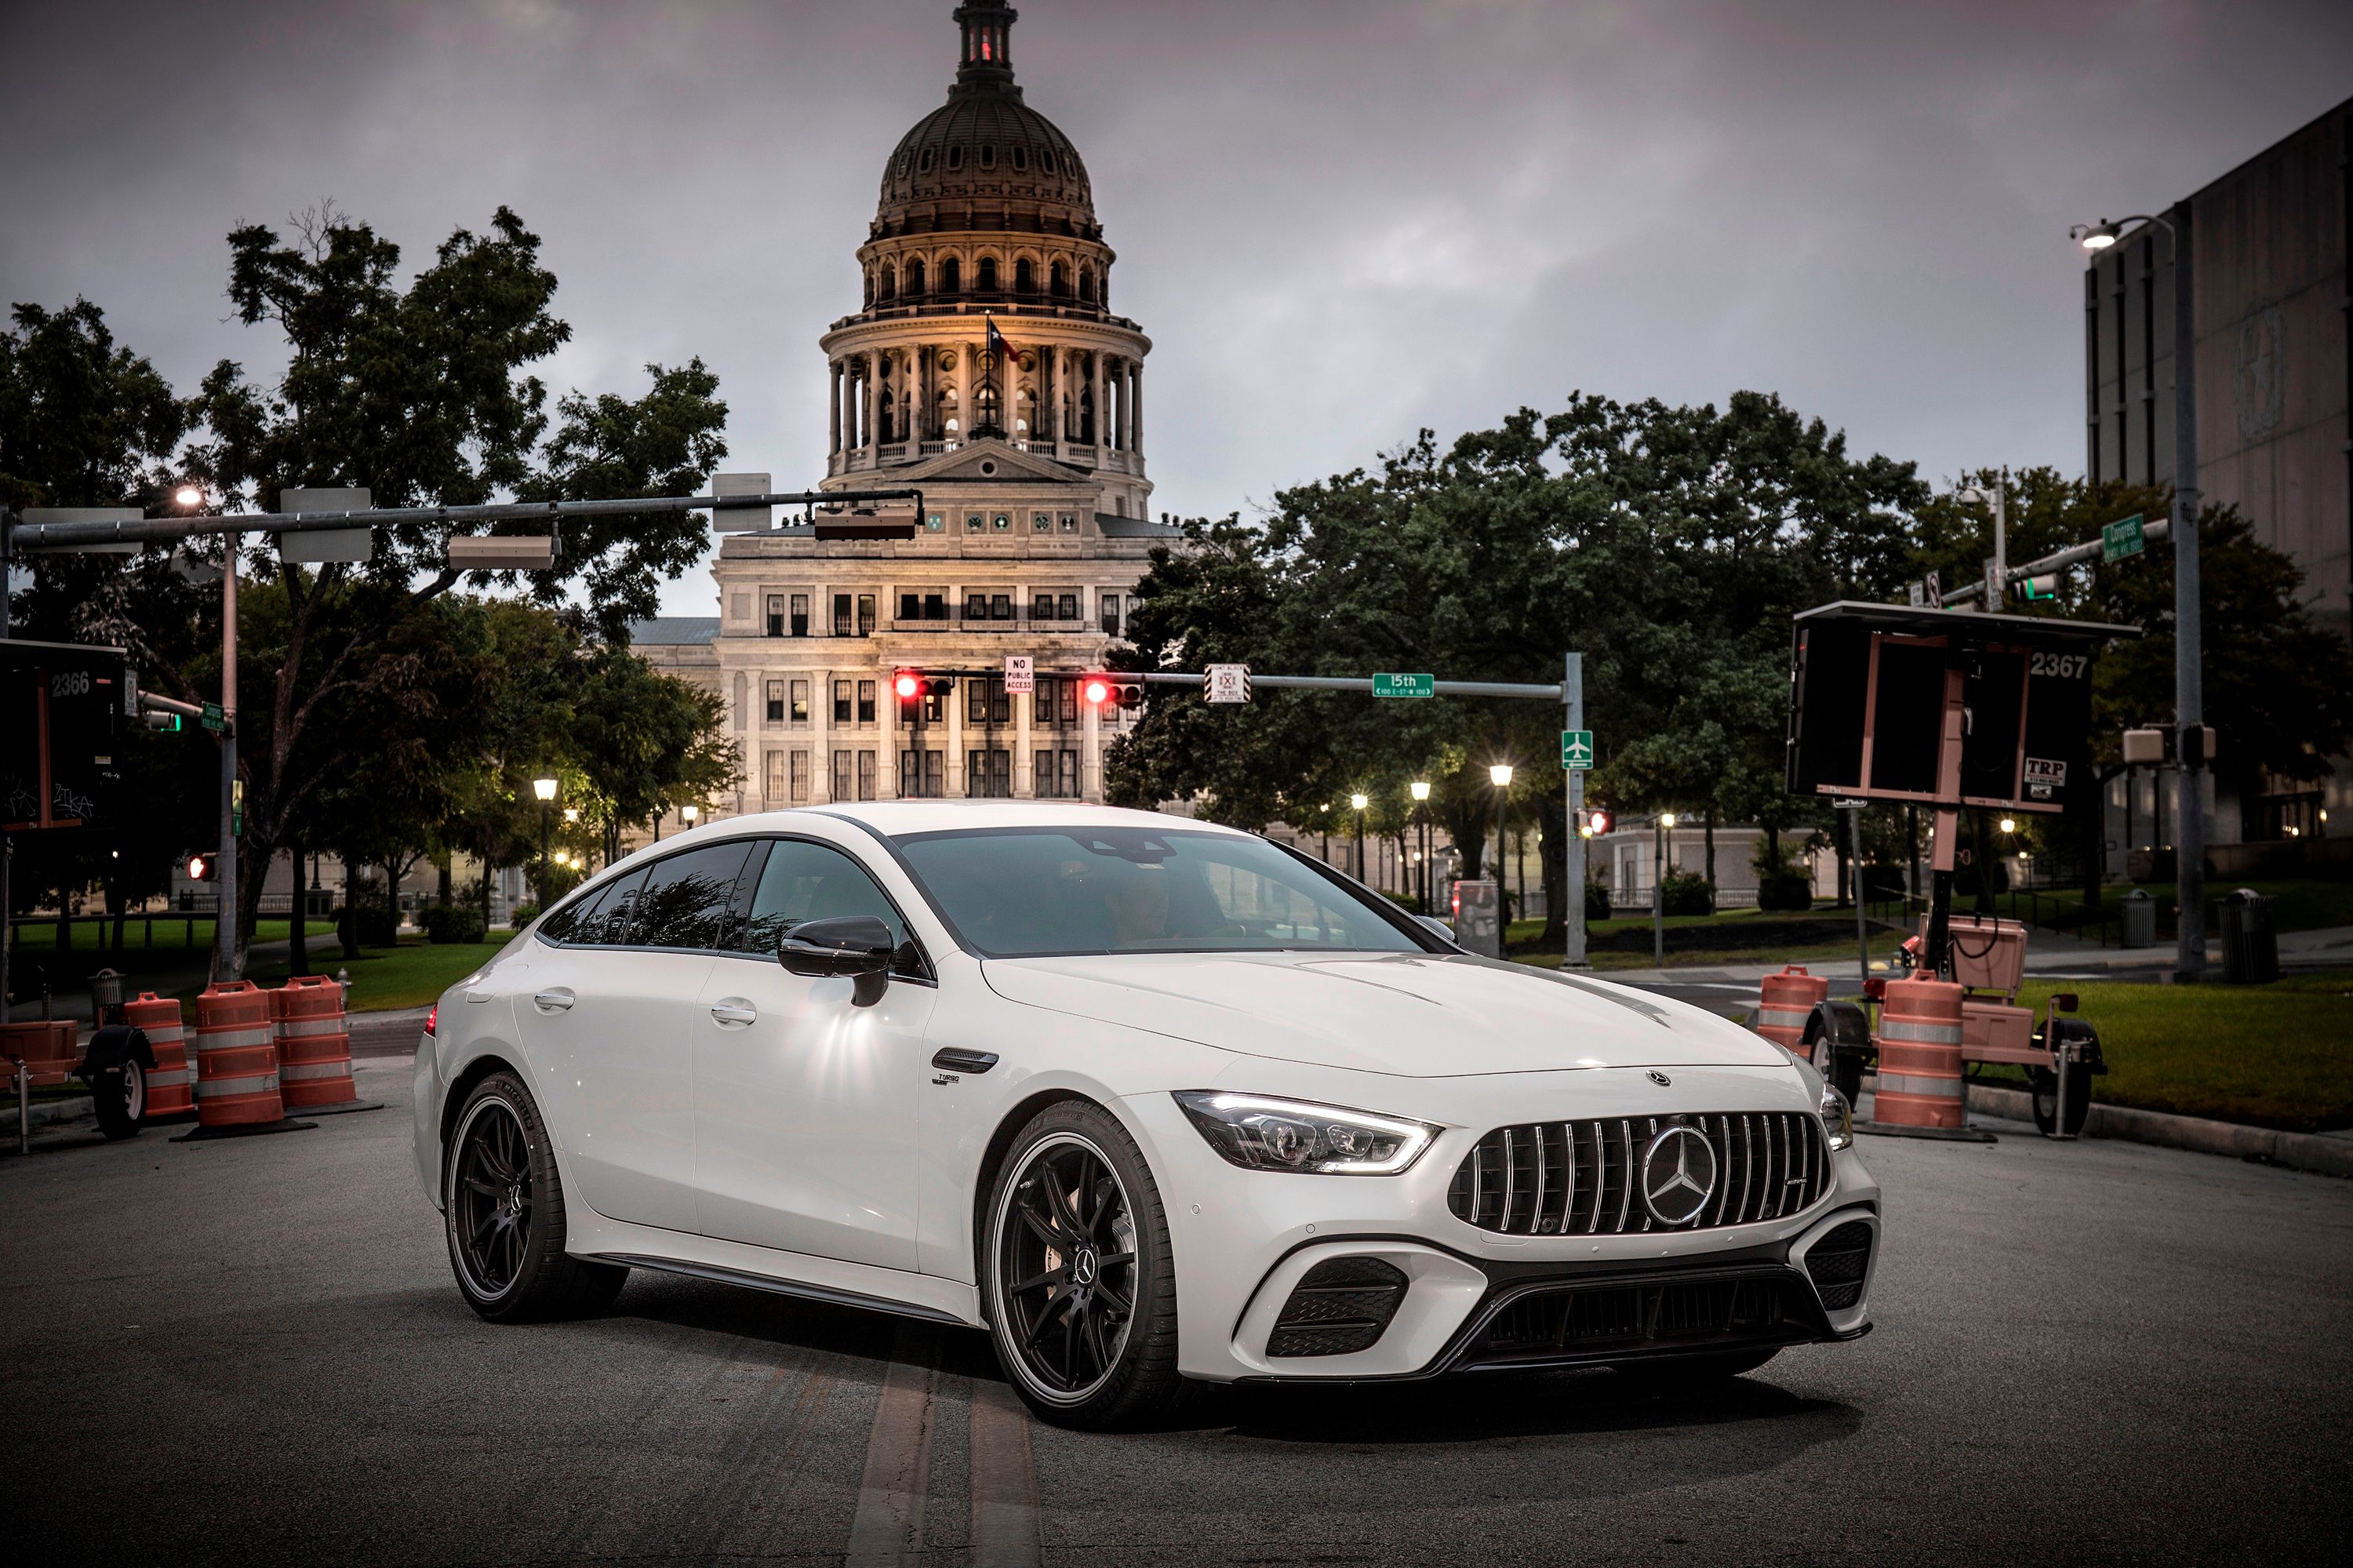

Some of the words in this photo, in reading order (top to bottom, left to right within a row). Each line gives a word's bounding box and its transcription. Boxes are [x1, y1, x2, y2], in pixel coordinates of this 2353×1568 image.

[2111, 521, 2137, 543] Congress
[1013, 660, 1025, 668] NO
[2030, 652, 2089, 679] 2367
[51, 671, 89, 697] 2366
[1391, 675, 1417, 687] 15th
[2028, 760, 2064, 776] TRP
[503, 1083, 535, 1131] MICHELIN
